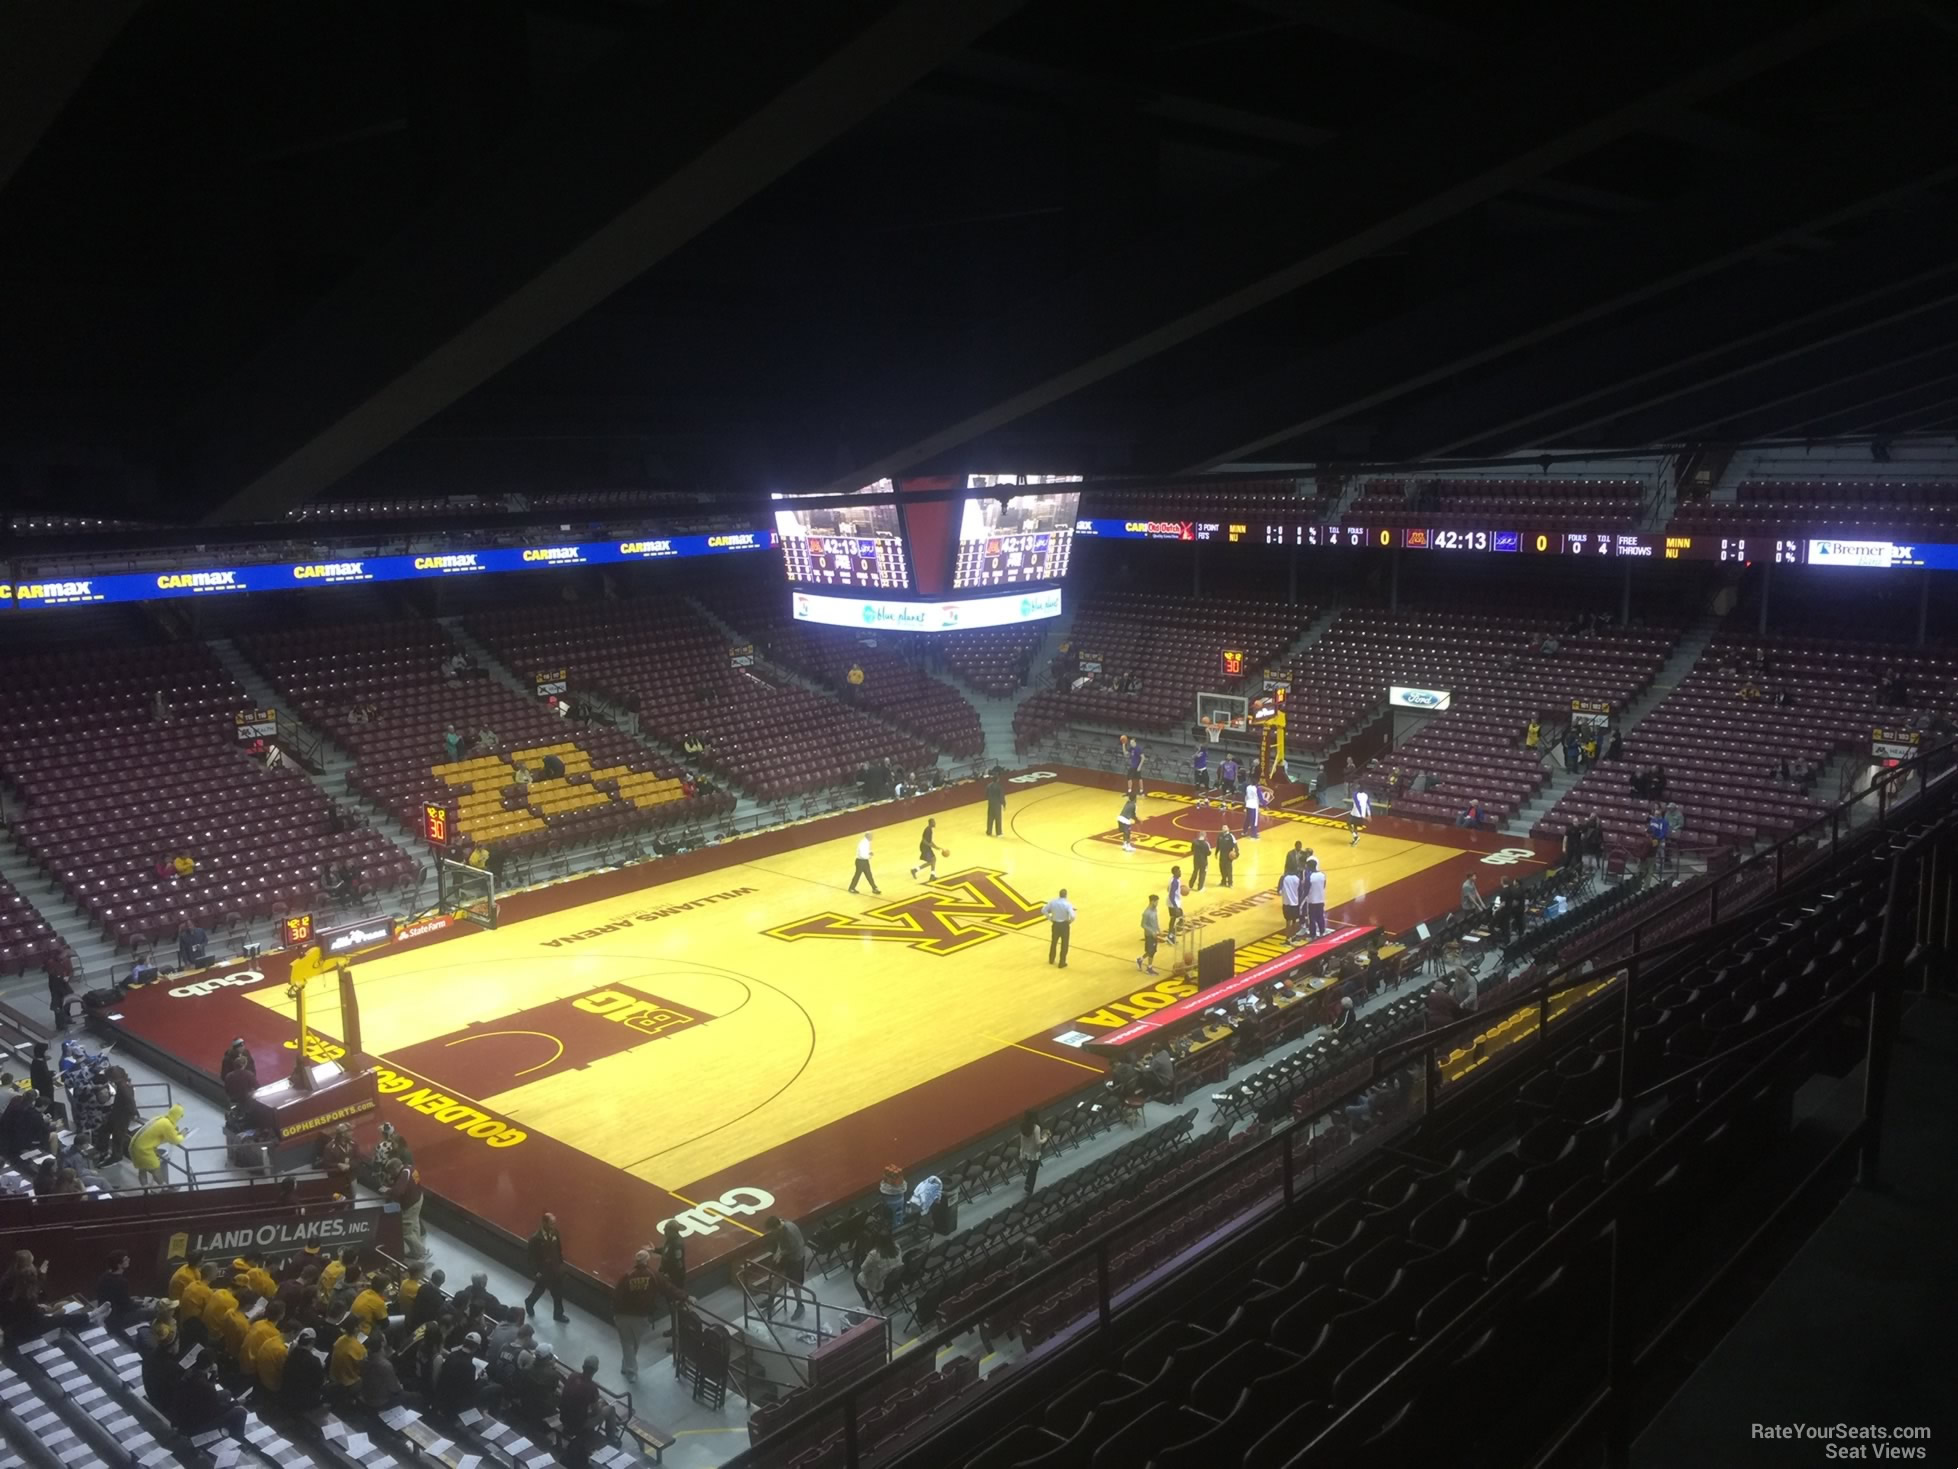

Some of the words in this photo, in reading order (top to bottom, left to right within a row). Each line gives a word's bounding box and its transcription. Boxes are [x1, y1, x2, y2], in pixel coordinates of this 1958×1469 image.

[1125, 522, 1147, 533] CAR
[1002, 535, 1034, 553] 42:13
[1329, 535, 1338, 545] 4
[1380, 530, 1390, 545] 0
[1434, 531, 1487, 550] 42:13
[1536, 535, 1547, 551] 0
[1568, 534, 1587, 542] FOULS
[1619, 536, 1638, 546] FREE
[1666, 538, 1691, 549] MINN
[824, 538, 858, 555] 42:13
[1573, 542, 1581, 554] 0
[1598, 543, 1607, 555] 4
[1618, 546, 1652, 557] THROWS
[1665, 549, 1679, 559] NU
[1832, 542, 1885, 556] Bremer
[1226, 660, 1240, 673] 30
[1407, 691, 1433, 704] Ford
[430, 819, 444, 840] 30
[635, 886, 760, 922] WILLIAMS
[292, 928, 307, 940] 30
[410, 926, 428, 938] State
[428, 920, 446, 931] Farm
[538, 919, 635, 948] ARENA
[168, 971, 265, 998] Cub
[395, 1087, 528, 1148] GOLDEN
[656, 1186, 775, 1238] Cub
[195, 1229, 254, 1251] LAND
[255, 1218, 346, 1246] O'LAKES,
[348, 1221, 370, 1234] INC.
